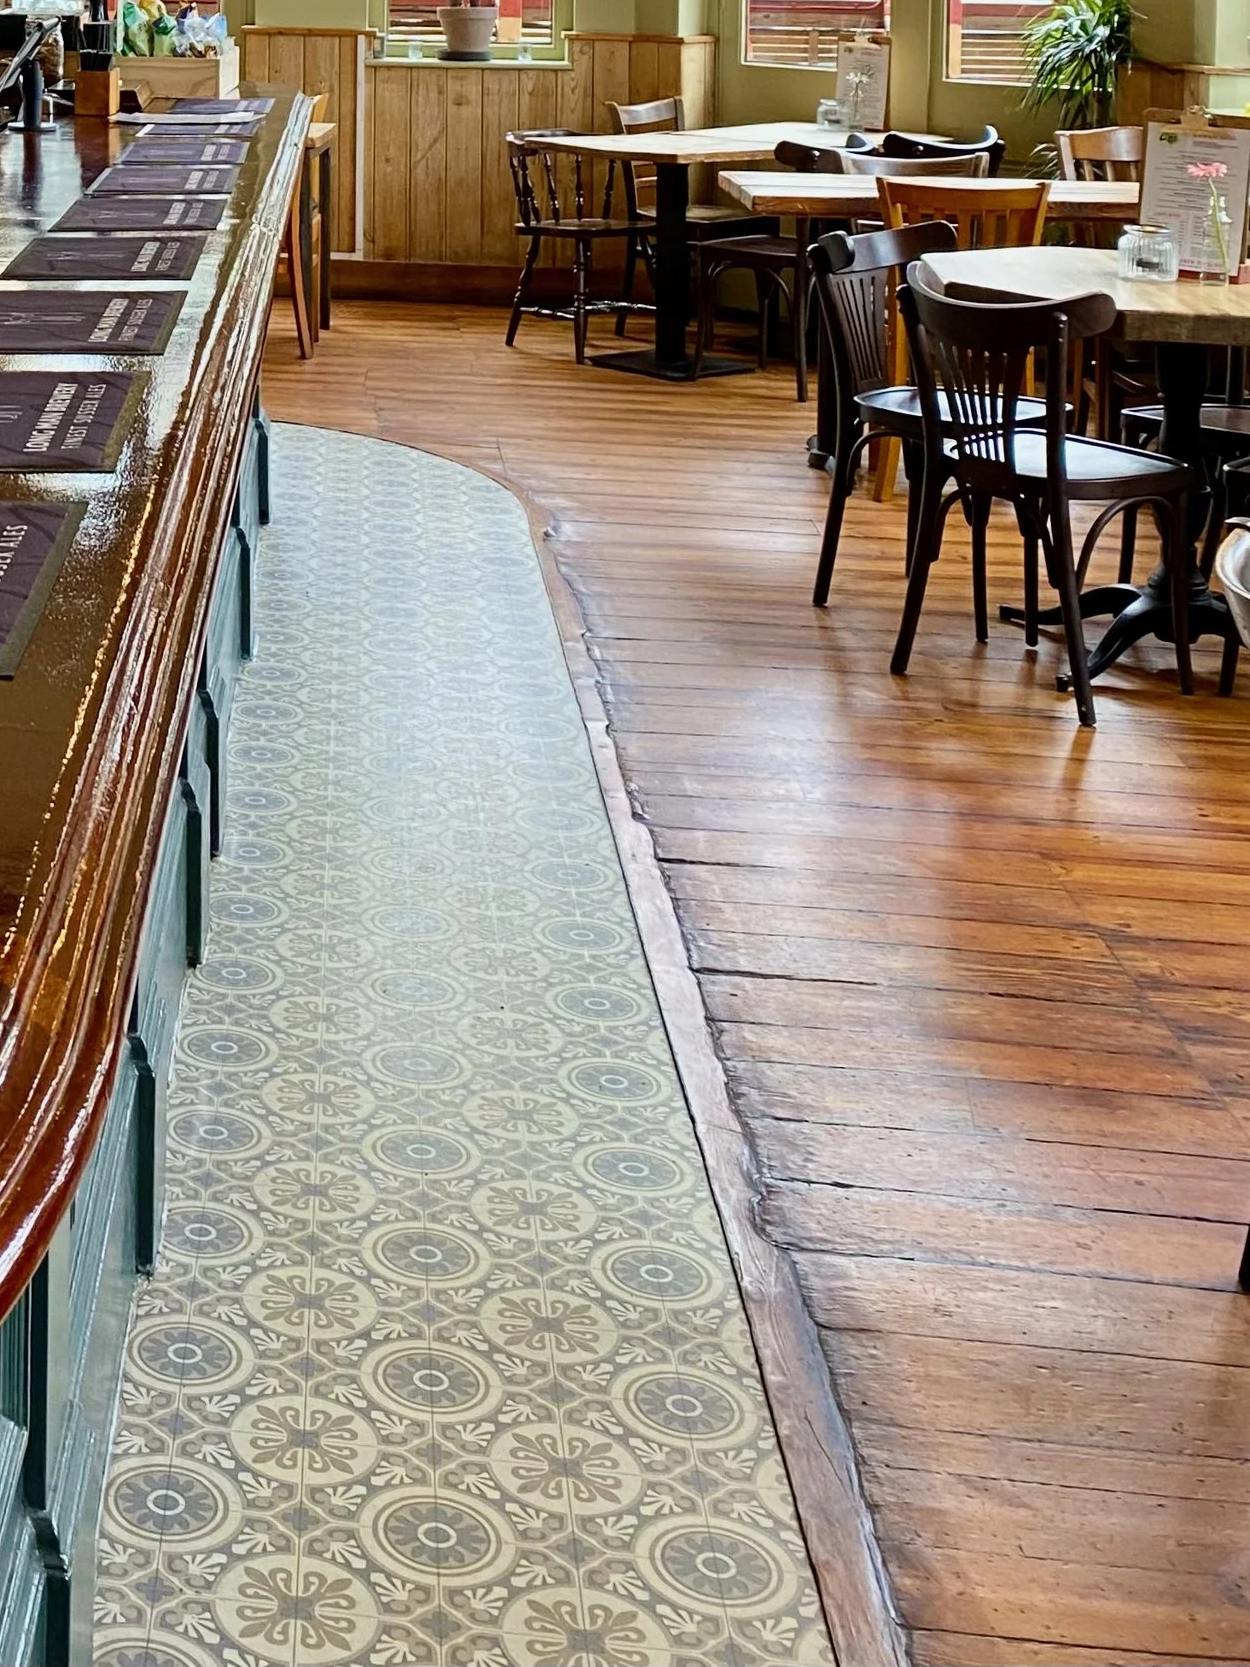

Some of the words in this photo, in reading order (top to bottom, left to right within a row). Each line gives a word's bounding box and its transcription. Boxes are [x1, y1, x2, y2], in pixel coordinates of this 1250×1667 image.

[44, 382, 79, 412] BREWERY
[85, 383, 107, 398] ALES
[34, 412, 65, 429] MAN
[73, 399, 100, 424] SUSSEX
[23, 430, 55, 452] LONG
[60, 425, 89, 450] FINEST
